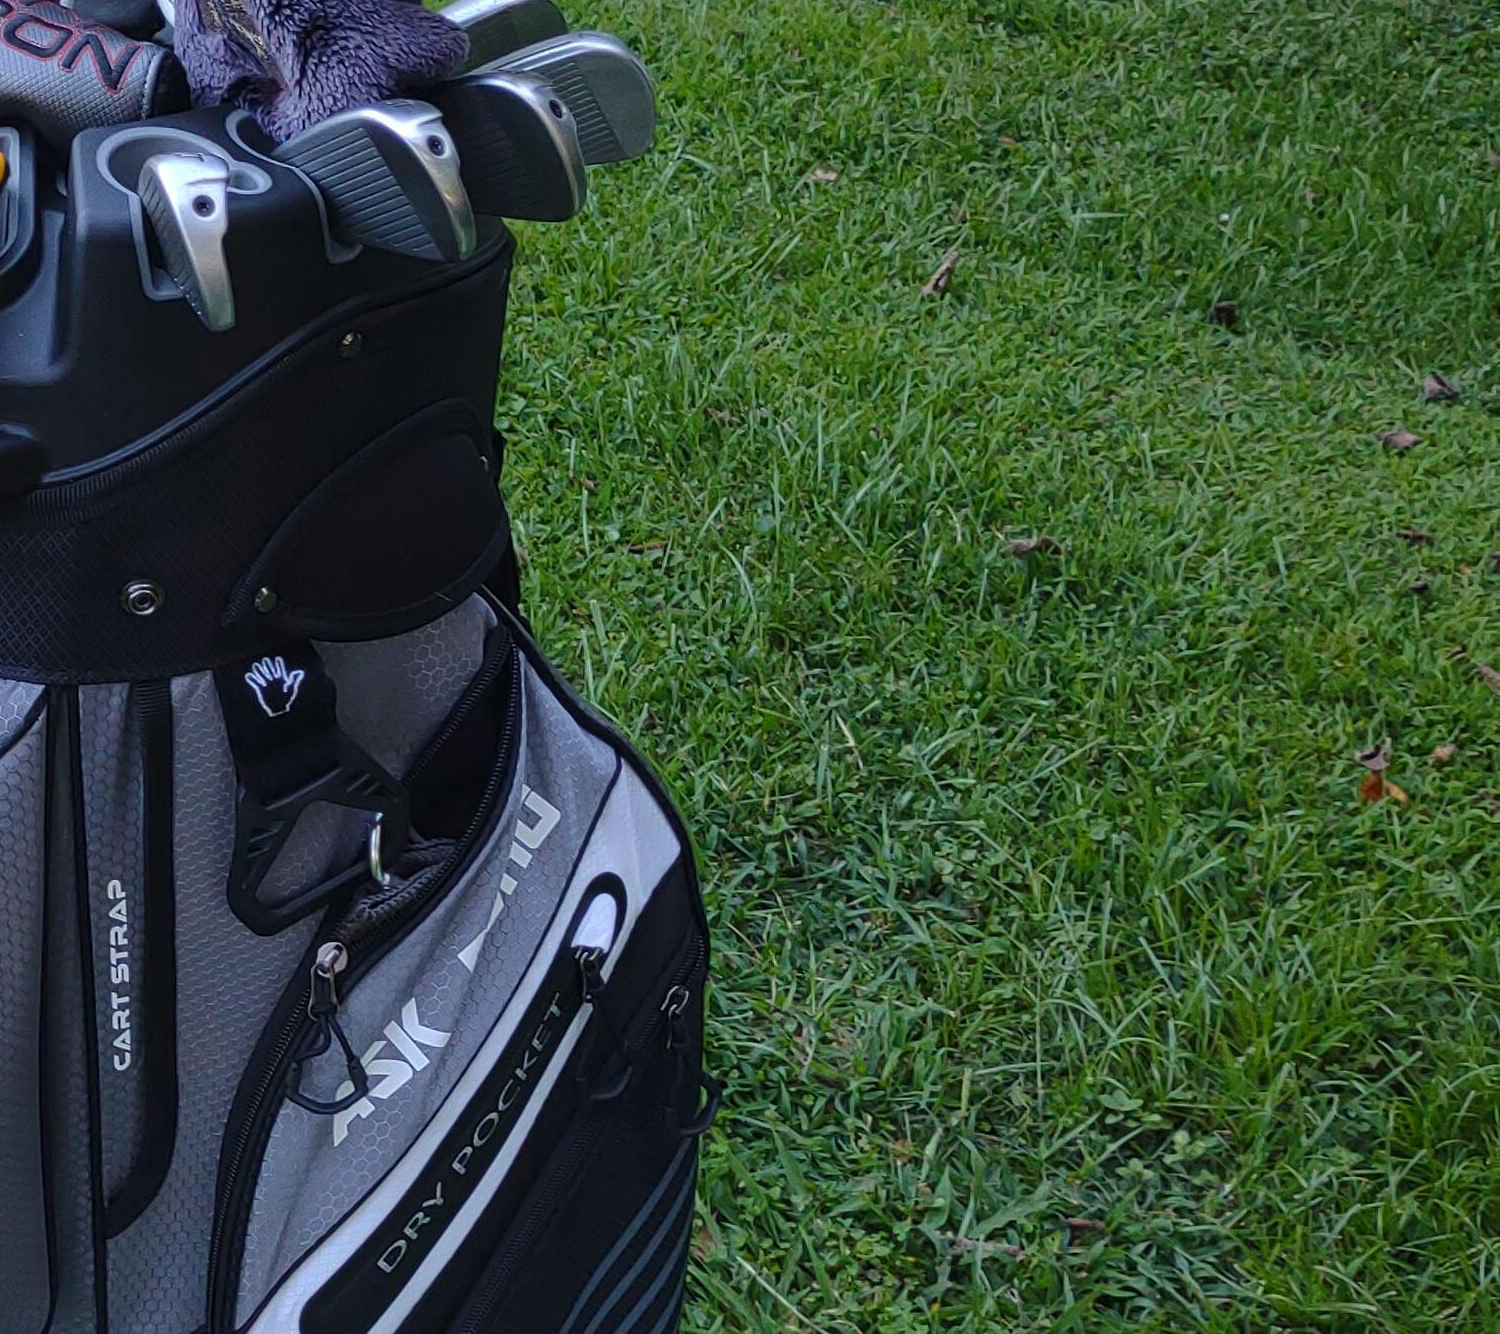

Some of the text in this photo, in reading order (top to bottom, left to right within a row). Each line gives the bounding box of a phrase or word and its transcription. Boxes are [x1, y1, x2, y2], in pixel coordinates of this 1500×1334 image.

[107, 879, 132, 1071] CART STRAP
[333, 997, 453, 1147] ASK
[376, 1180, 444, 1274] DRY
[451, 991, 562, 1175] POCKET
